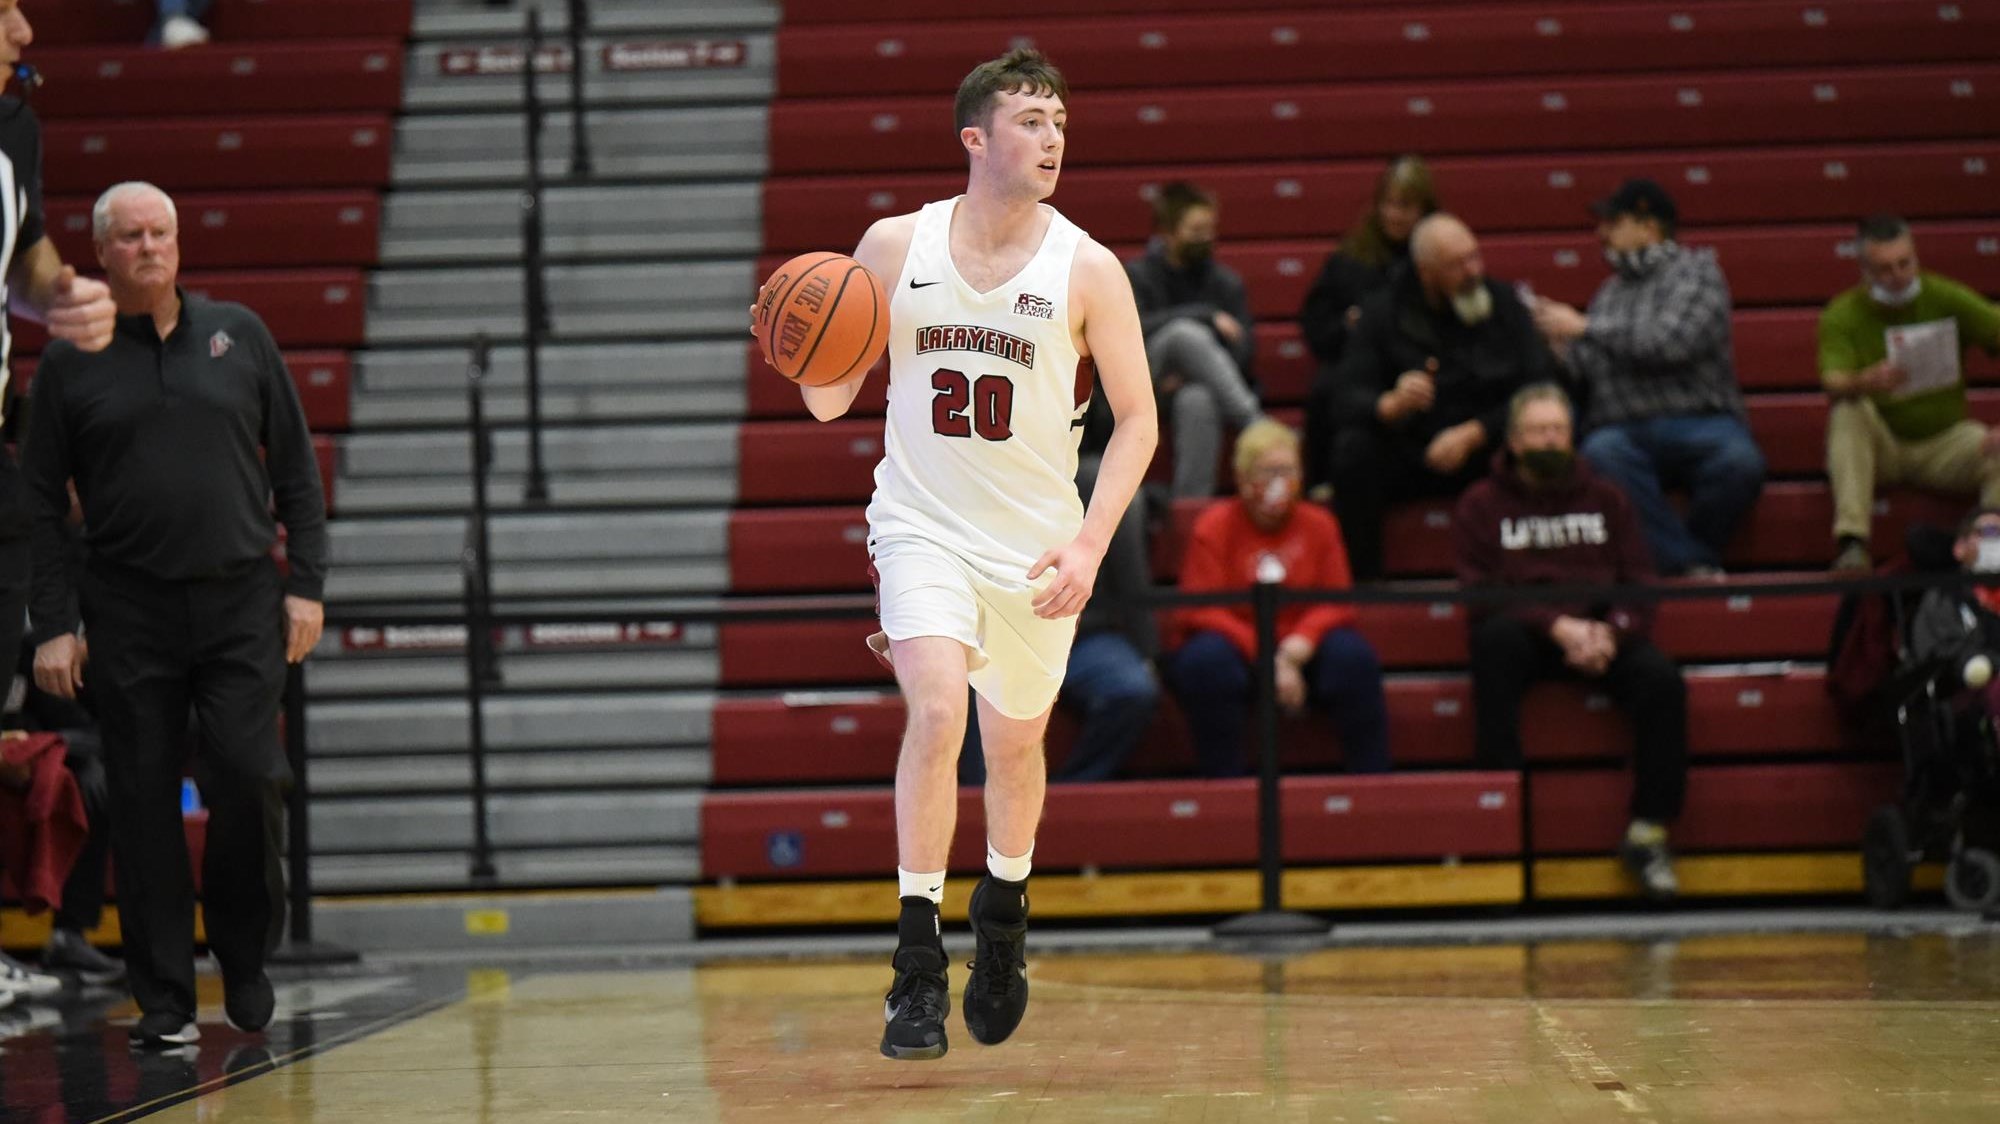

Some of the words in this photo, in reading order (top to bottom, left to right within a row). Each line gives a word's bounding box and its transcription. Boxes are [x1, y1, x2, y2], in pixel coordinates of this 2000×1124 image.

[794, 275, 832, 315] THE
[1013, 308, 1054, 320] LEAGUE
[1014, 303, 1055, 315] PATRIOT
[778, 311, 812, 360] ROCK
[917, 326, 1035, 370] LAFAYETTE
[931, 368, 1014, 442] 20
